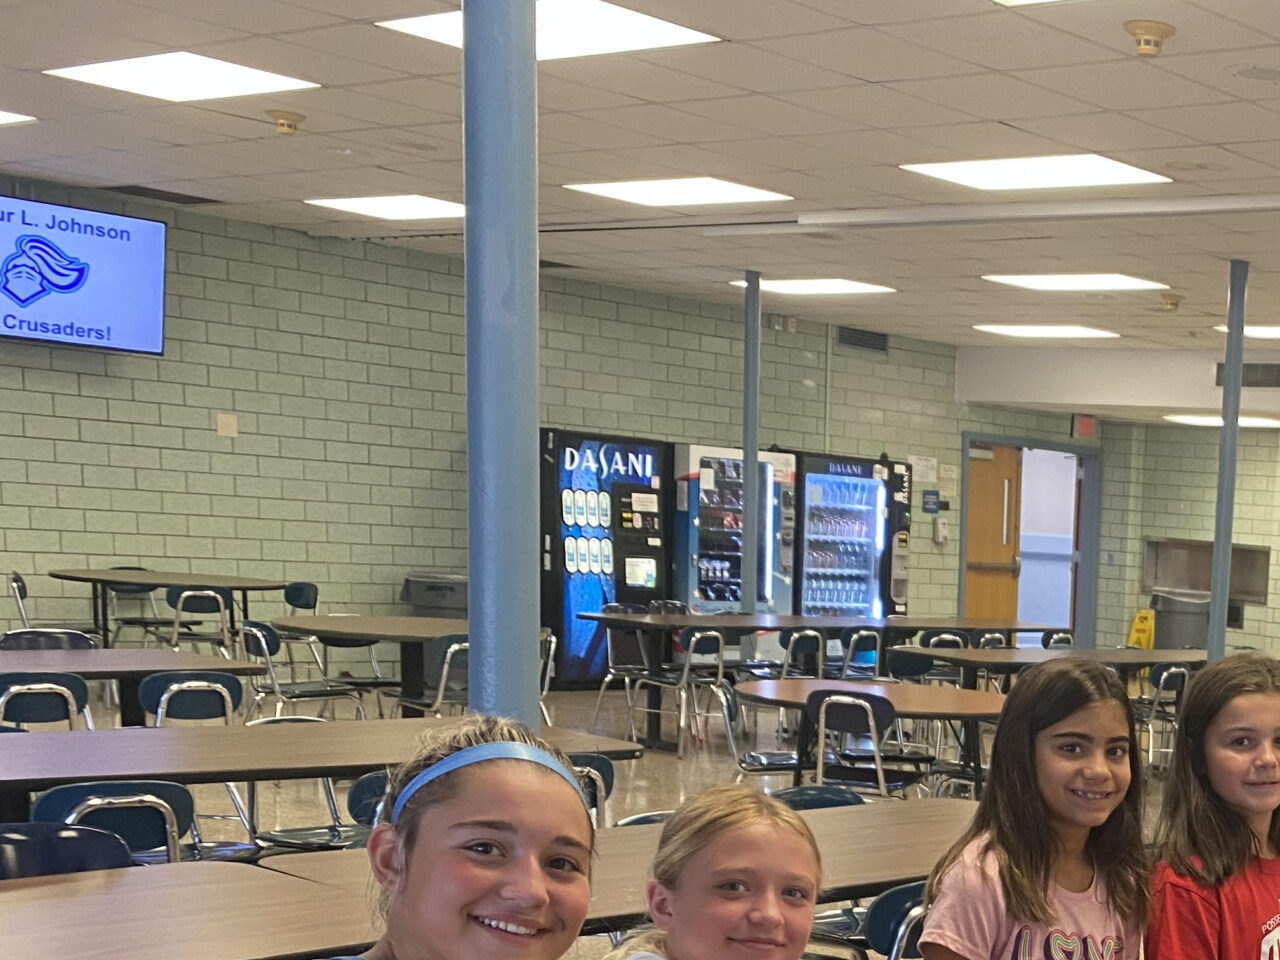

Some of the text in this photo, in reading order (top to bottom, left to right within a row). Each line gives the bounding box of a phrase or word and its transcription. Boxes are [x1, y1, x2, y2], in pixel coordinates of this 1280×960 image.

[21, 211, 39, 227] L.
[46, 215, 131, 242] Johnson
[3, 314, 111, 341] Crusaders!
[564, 444, 653, 479] DASANI
[829, 463, 863, 475] DASANI
